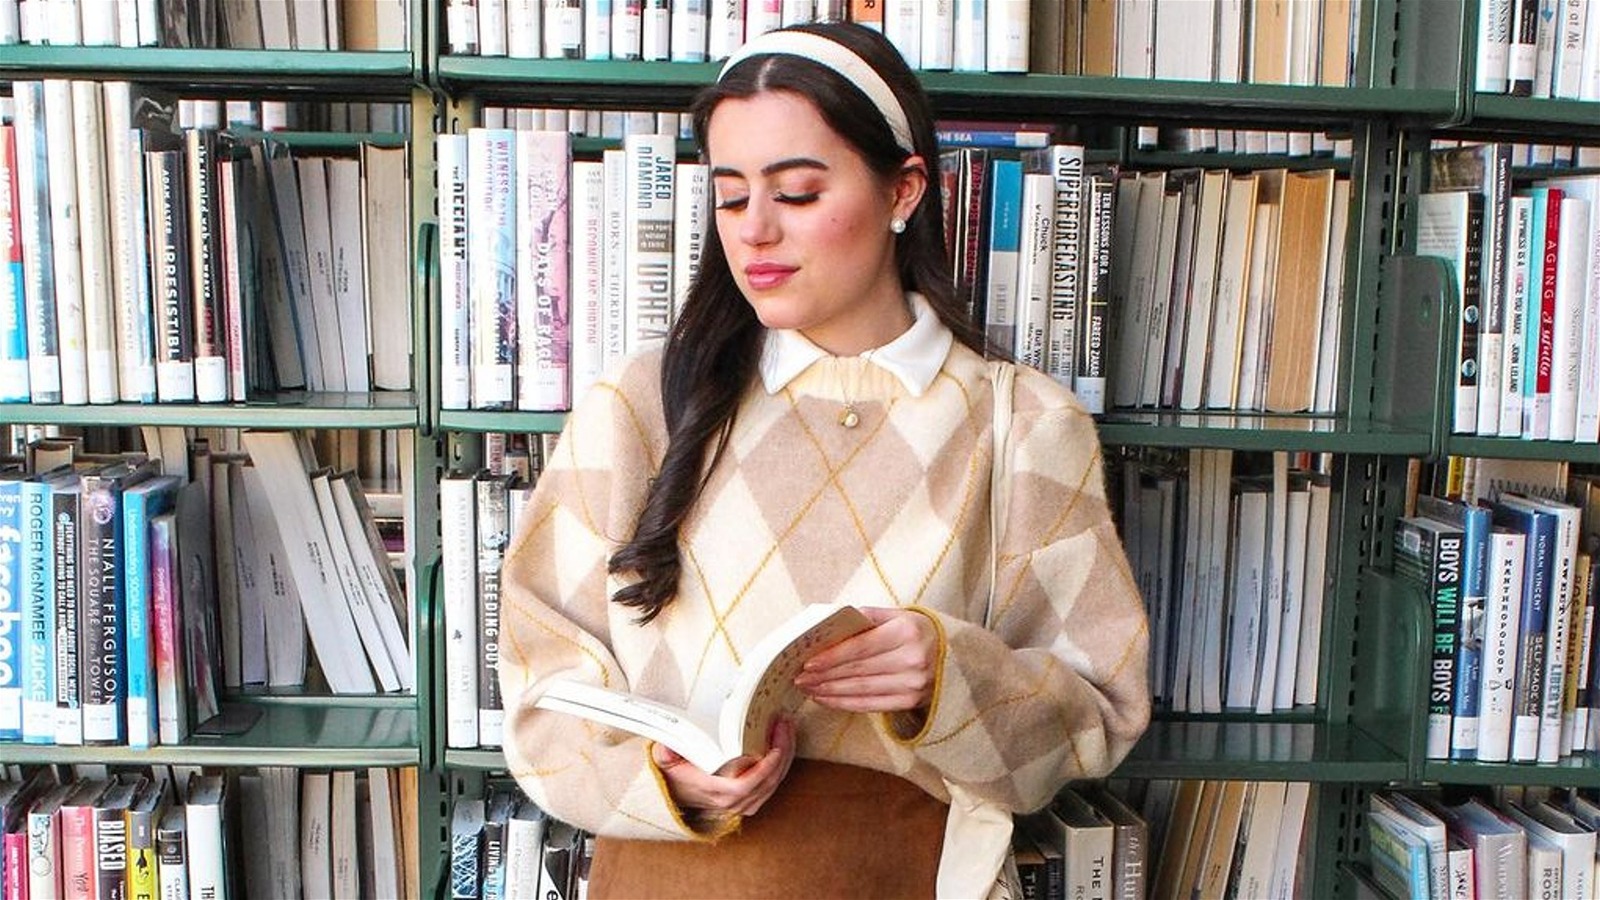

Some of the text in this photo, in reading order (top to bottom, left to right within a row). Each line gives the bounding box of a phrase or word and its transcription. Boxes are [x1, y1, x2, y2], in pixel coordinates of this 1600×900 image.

[1567, 31, 1580, 49] Me
[637, 147, 653, 209] DIAMOND
[655, 157, 671, 200] JARED
[1102, 192, 1112, 209] TEN
[610, 211, 620, 250] BORN
[1039, 217, 1050, 253] Chuck
[1053, 157, 1081, 321] SUPERFORECASTING
[1100, 210, 1111, 248] LESSONS
[1100, 249, 1110, 267] FOR
[1543, 240, 1557, 300] AGING
[164, 245, 180, 359] IRRESISTIBL
[203, 264, 212, 298] weave
[610, 273, 620, 320] THIRD
[637, 263, 669, 342] UPHEA
[537, 243, 552, 370] DAYS OF RAGE
[1514, 297, 1523, 311] YOU
[1033, 329, 1043, 369] But Wha
[1090, 315, 1102, 378] FAREED ZAKAR
[1509, 343, 1520, 393] JOHN LELAND
[88, 537, 99, 563] THE
[102, 537, 116, 593] NIALL
[1437, 538, 1461, 583] BOYS
[129, 575, 139, 607] SOCIAL
[1533, 535, 1547, 612] NORAH VINCENT
[1558, 558, 1570, 616] SWEET
[0, 525, 22, 688] faceboo
[30, 493, 48, 701] ROGER McNAMEE ZUCKE
[88, 568, 100, 625] SQUARE
[484, 564, 498, 637] BLEEDING
[1436, 588, 1457, 631] WILL
[102, 603, 117, 706] FERGUSON
[486, 643, 499, 671] OUT
[1435, 633, 1454, 654] BE
[1431, 659, 1454, 702] BOYS
[1531, 636, 1544, 698] SELF-MADE
[1529, 704, 1538, 717] MA
[1547, 664, 1563, 719] LIBERTY
[98, 820, 126, 871] BIASED
[488, 840, 501, 872] LIVING
[1129, 836, 1140, 855] the
[488, 875, 498, 885] IN
[1091, 856, 1105, 889] THE
